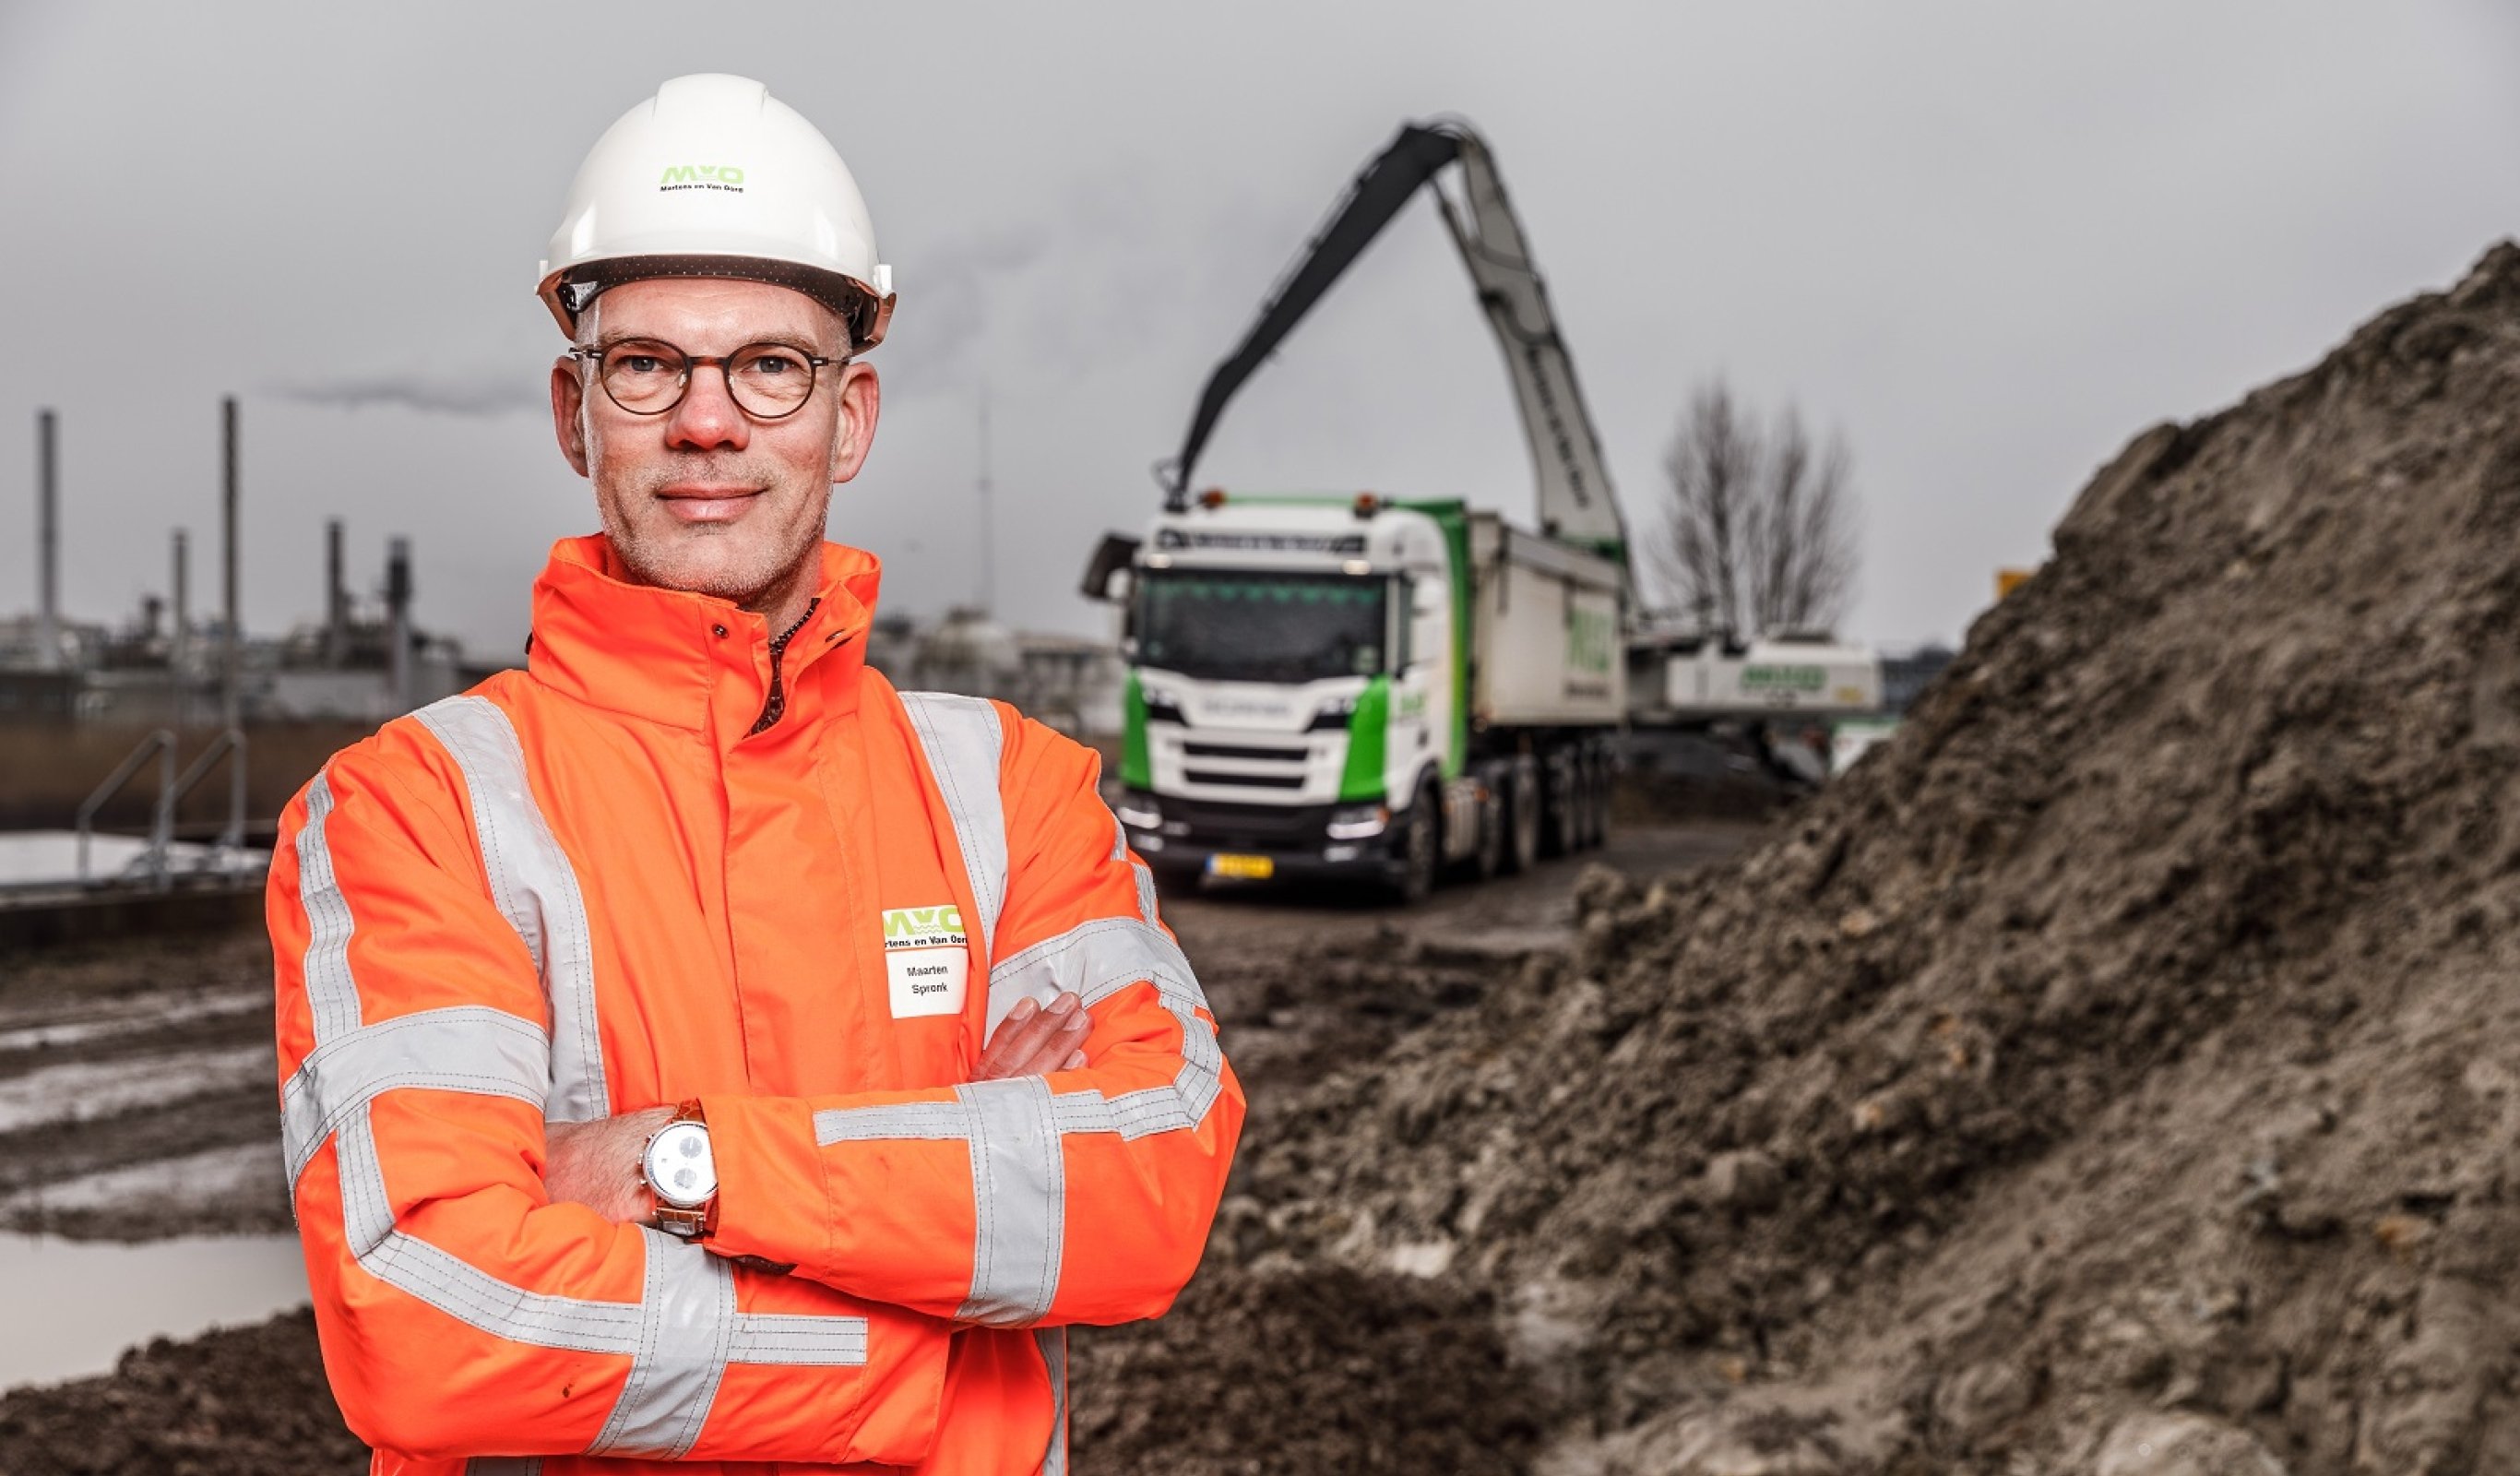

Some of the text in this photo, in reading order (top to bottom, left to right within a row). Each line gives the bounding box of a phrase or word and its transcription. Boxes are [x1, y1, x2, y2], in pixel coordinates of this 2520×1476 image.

[886, 939, 911, 947] rtens
[929, 936, 947, 945] Van
[951, 934, 968, 944] Oor
[907, 965, 948, 976] Maarten
[911, 982, 948, 997] Spronk
